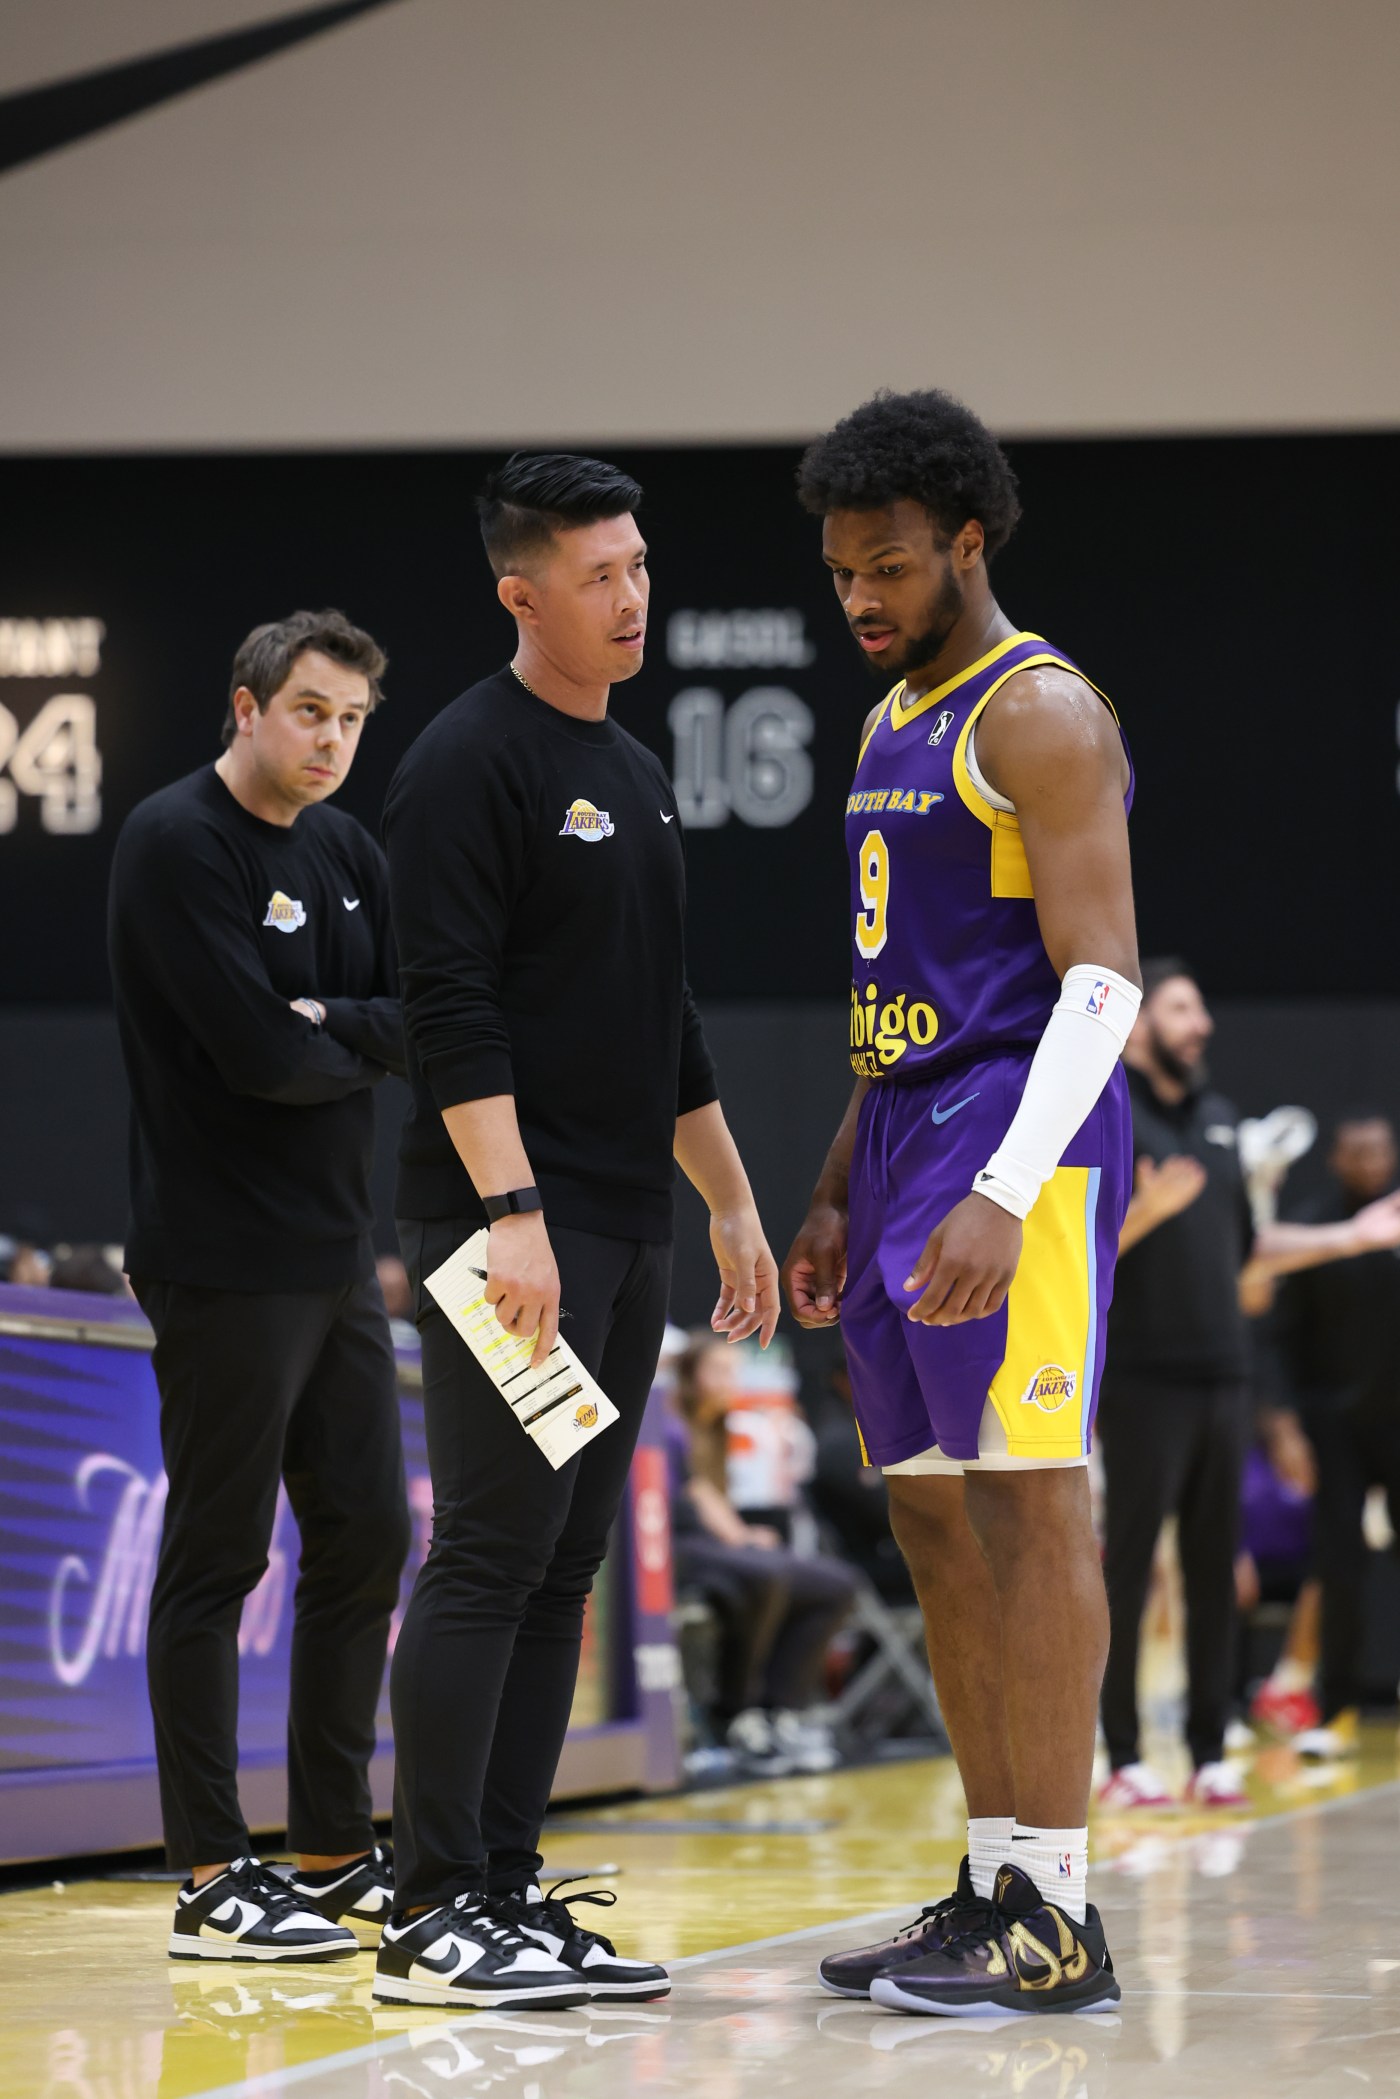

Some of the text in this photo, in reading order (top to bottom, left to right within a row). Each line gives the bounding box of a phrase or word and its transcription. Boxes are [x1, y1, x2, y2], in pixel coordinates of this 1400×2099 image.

[667, 686, 815, 828] 16
[846, 788, 944, 816] OUTH BAY
[560, 810, 614, 836] LAKERS
[855, 830, 889, 959] 9
[1025, 1378, 1076, 1400] LAKERS
